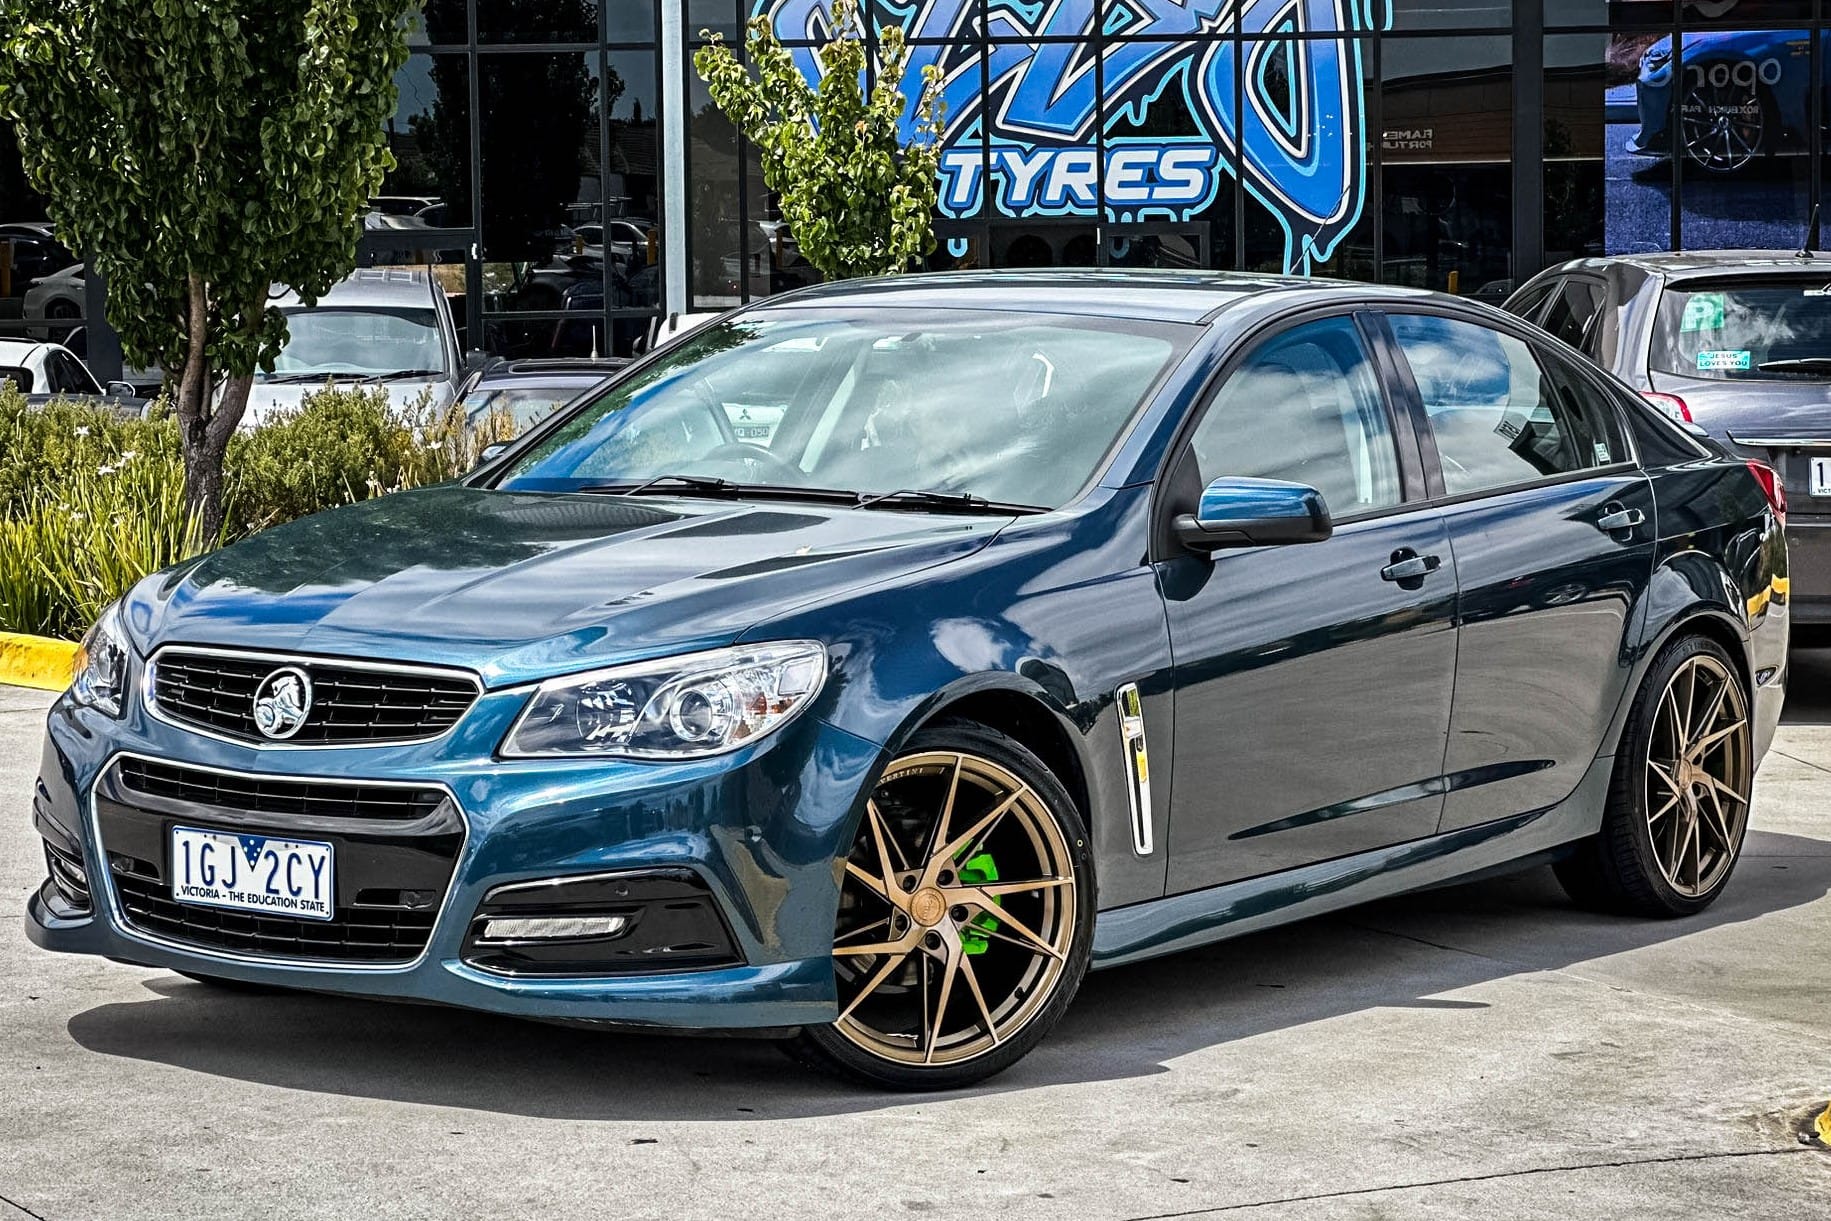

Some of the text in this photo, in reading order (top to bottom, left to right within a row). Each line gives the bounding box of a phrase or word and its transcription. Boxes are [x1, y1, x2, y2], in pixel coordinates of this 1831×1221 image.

[944, 149, 1213, 203] TYRES
[1684, 301, 1714, 329] P
[182, 840, 326, 900] 1GJ 2CY
[181, 885, 220, 900] VICTORIA
[228, 891, 245, 903] THE
[247, 893, 298, 909] EDUCATION
[300, 900, 325, 912] STATE
